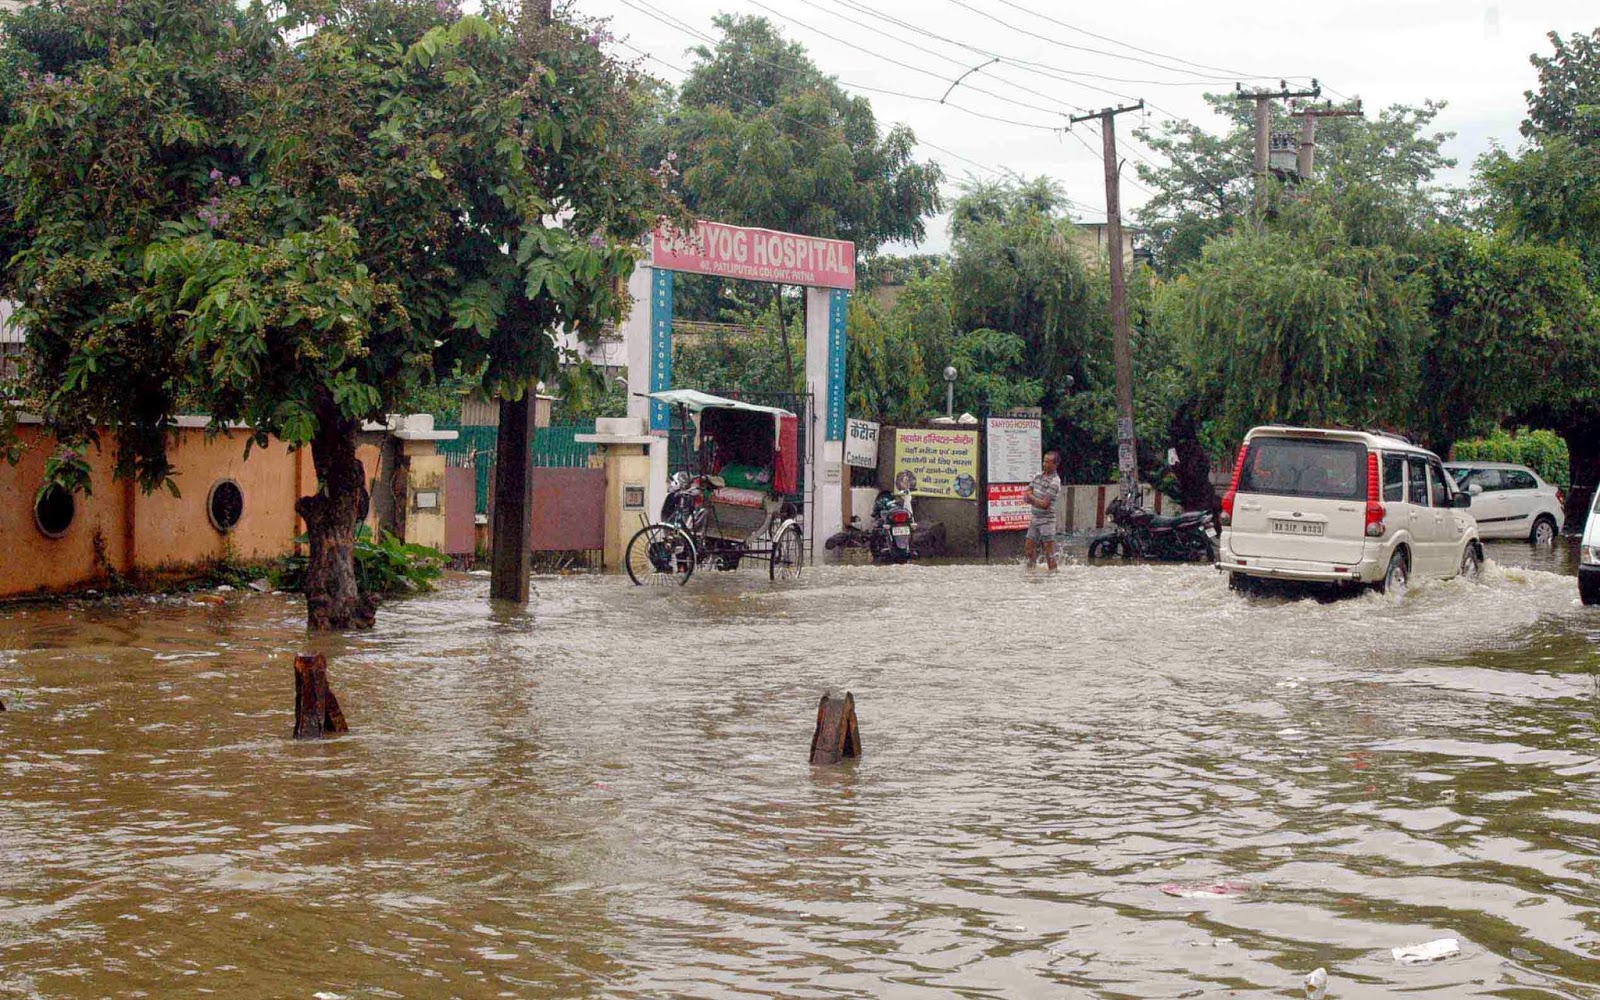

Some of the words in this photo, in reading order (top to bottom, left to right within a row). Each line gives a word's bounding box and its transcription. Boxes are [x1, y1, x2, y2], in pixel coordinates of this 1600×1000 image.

[753, 234, 849, 274] HOSPITAL
[658, 320, 666, 421] RECOGNIED
[846, 451, 872, 466] Canteen
